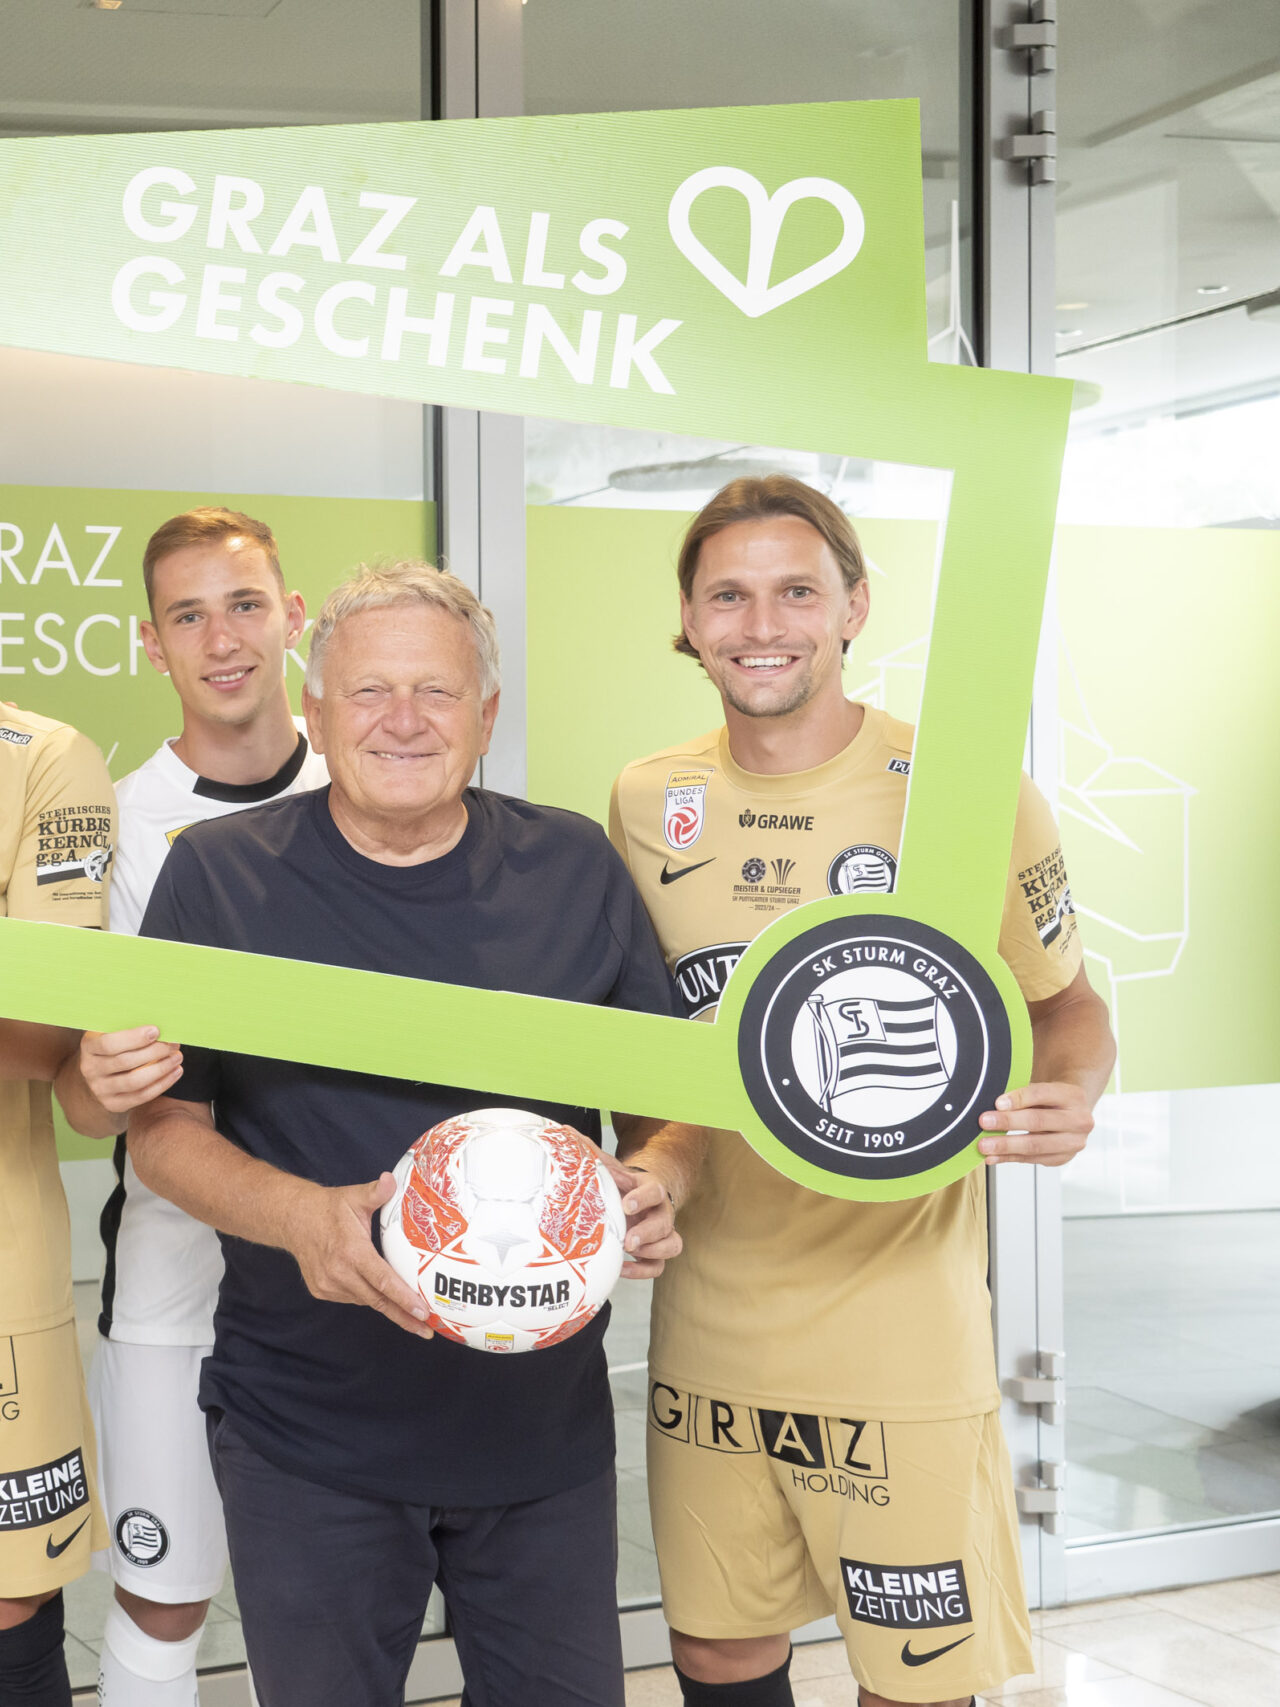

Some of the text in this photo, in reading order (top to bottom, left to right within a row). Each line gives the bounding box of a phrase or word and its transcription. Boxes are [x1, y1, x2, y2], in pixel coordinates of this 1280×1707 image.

[121, 166, 631, 296] GRAZ ALS
[111, 255, 685, 395] GESCHENK
[668, 787, 703, 798] BUNDES
[672, 775, 706, 783] ADMIRAL
[38, 805, 111, 820] STEIRISCHES
[675, 796, 694, 806] LIGA
[37, 817, 111, 836] KÜRBIS
[757, 814, 815, 831] GRAWE
[36, 849, 82, 867] g.g.A.
[767, 886, 801, 894] CUPSIEGER
[812, 946, 961, 1000] SK STURM GRAZ
[815, 1118, 905, 1148] SEIT 1909
[434, 1272, 570, 1308] DERBYSTAR
[651, 1382, 873, 1472] GRAZ
[792, 1469, 891, 1507] HOLDING
[846, 1566, 960, 1596] KLEINE
[851, 1591, 964, 1622] ZEITUNG
